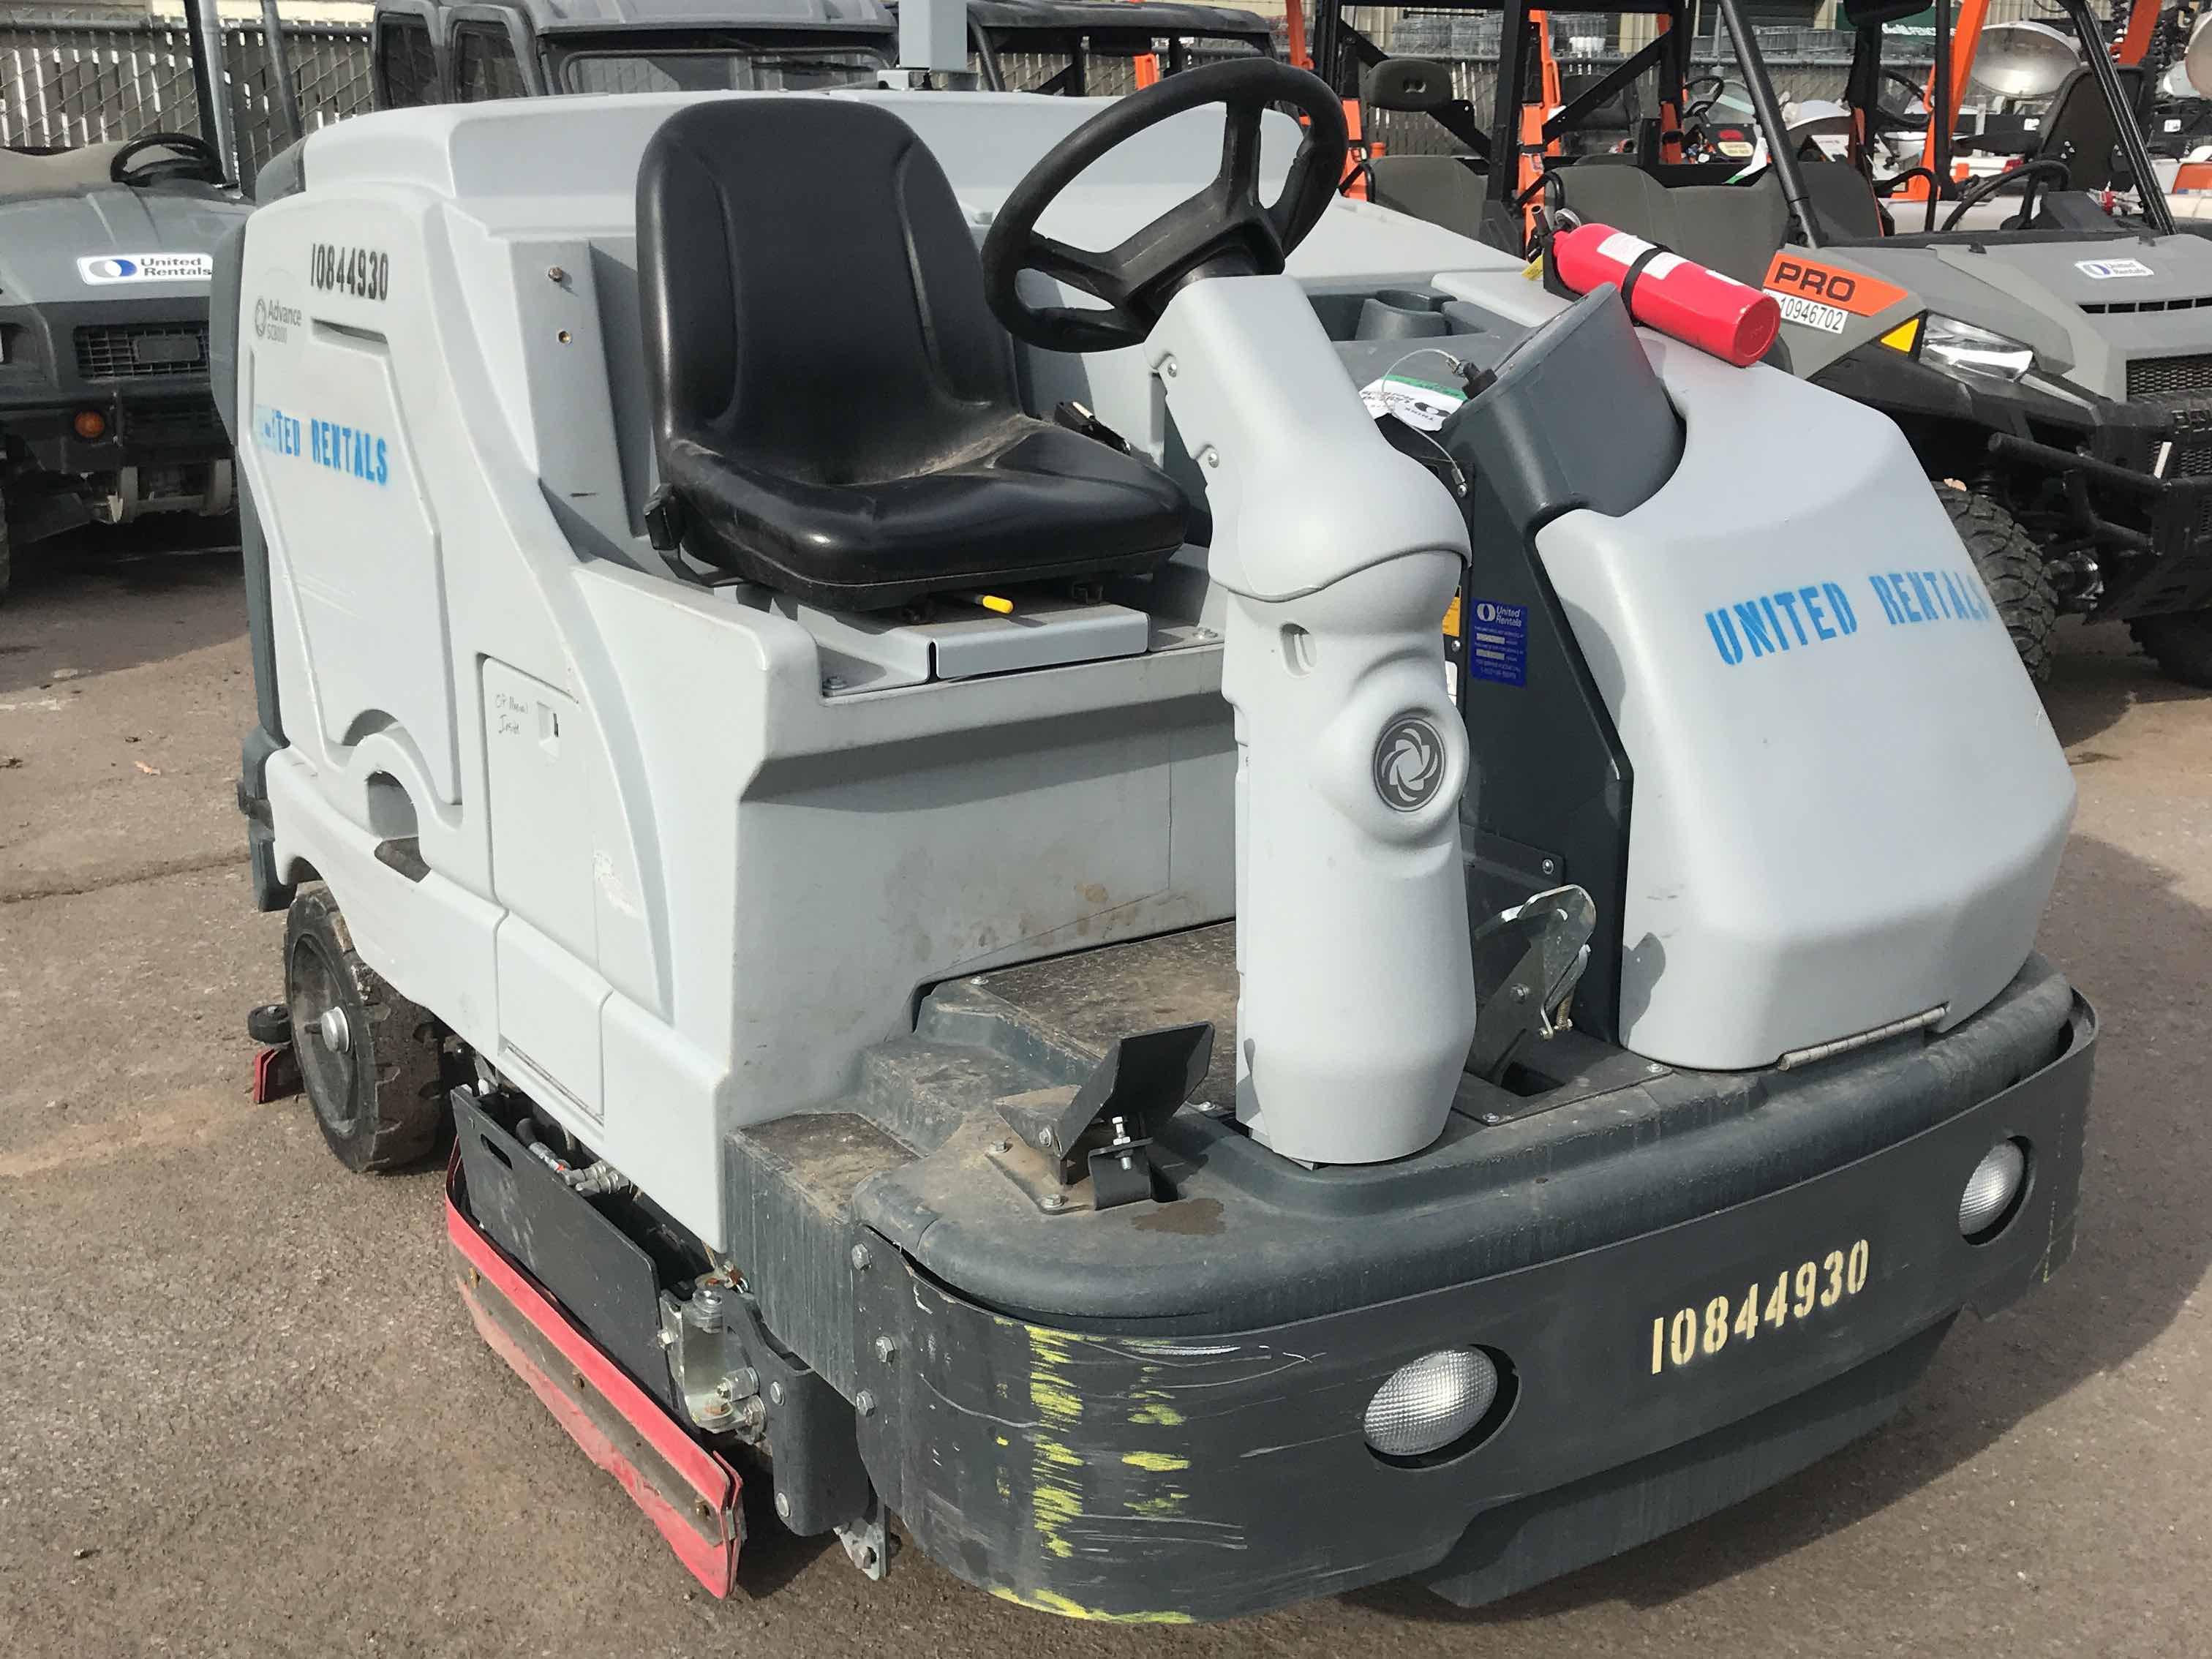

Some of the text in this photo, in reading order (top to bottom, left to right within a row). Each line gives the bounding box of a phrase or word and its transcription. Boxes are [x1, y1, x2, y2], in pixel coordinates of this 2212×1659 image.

[140, 257, 202, 267] United
[144, 266, 213, 276] Rentals
[310, 243, 389, 301] 10844930
[1773, 261, 1856, 303] PRO
[268, 298, 303, 327] Advance
[1780, 296, 1843, 331] 10946702
[311, 418, 388, 486] RENTALS
[1496, 605, 1521, 618] United
[1496, 614, 1522, 627] Rentals
[1704, 570, 1991, 666] UNITED RENTALS
[1651, 1238, 1869, 1375] 10844930
